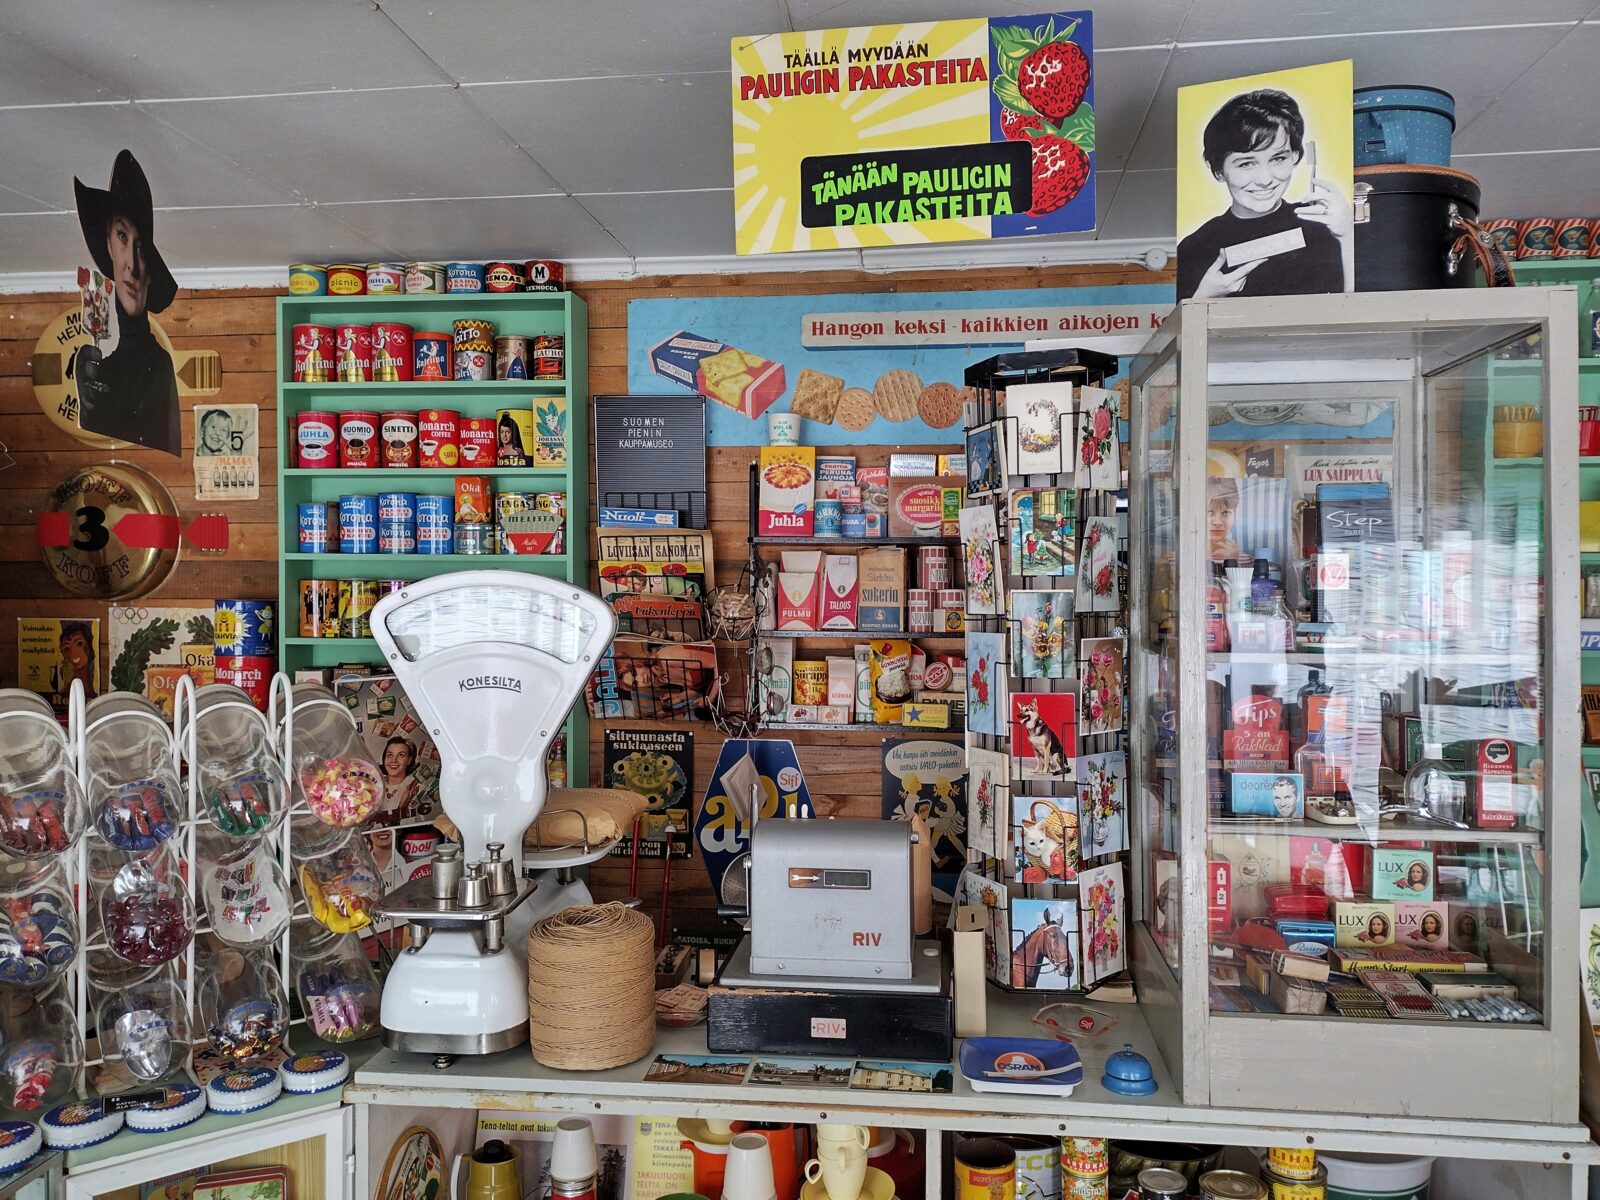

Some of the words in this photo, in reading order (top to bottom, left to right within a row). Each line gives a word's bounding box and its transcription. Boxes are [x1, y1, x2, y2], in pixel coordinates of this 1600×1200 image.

[784, 46, 839, 68] TÄÄLLÄ
[848, 40, 929, 63] MYYDÄÄN
[741, 68, 839, 100] PAULIGIN
[849, 58, 987, 91] PAKASTEITA
[812, 161, 897, 204] TÄNÄÄN
[902, 163, 1011, 195] PAULIGIN
[836, 191, 1013, 226] PAKASTEITA
[812, 321, 884, 340] Hangon
[895, 318, 946, 335] keksi
[961, 315, 1048, 334] kaikkien
[1059, 313, 1139, 333] aikojen
[419, 421, 455, 433] Monarch
[622, 417, 666, 427] SUOMEN
[343, 426, 372, 434] HUOMIO
[384, 425, 414, 434] SINETTI
[460, 429, 494, 439] Monarch
[628, 428, 663, 438] PIENIN
[231, 431, 244, 451] 5
[619, 439, 674, 449] KAUPPAMUSEO
[1247, 456, 1271, 468] Fazer
[1304, 469, 1323, 482] LUX
[1326, 468, 1382, 482] SAIPPUAA
[56, 474, 133, 504] KOFF
[537, 500, 561, 508] NGAS
[909, 496, 940, 505] suosikk
[905, 505, 940, 513] margarii
[508, 515, 556, 523] MELITTA
[604, 510, 646, 522] Nuoli
[768, 513, 804, 529] Juhla
[73, 505, 110, 552] 3
[1326, 510, 1383, 537] Step
[607, 545, 650, 558] LOVIISAN
[656, 544, 701, 558] SANOMAT
[57, 553, 130, 586] KOFF
[829, 601, 851, 610] TALOUS
[782, 609, 811, 618] PULMU
[795, 669, 828, 682] Siirapp
[458, 675, 522, 692] KONESILTA
[1235, 699, 1278, 728] Tips
[609, 731, 685, 743] sitruunasta
[613, 740, 683, 751] suklaaseen
[1232, 736, 1282, 752] Rakblad
[403, 841, 433, 854] O'boy
[1378, 862, 1404, 873] LUX
[1339, 915, 1364, 926] LUX
[852, 932, 882, 947] RIV
[816, 1022, 841, 1034] RIV
[998, 1061, 1042, 1073] OSRAM
[480, 1120, 518, 1131] Tena-teltat
[521, 1124, 535, 1132] ovat
[1272, 1149, 1312, 1164] LIHA
